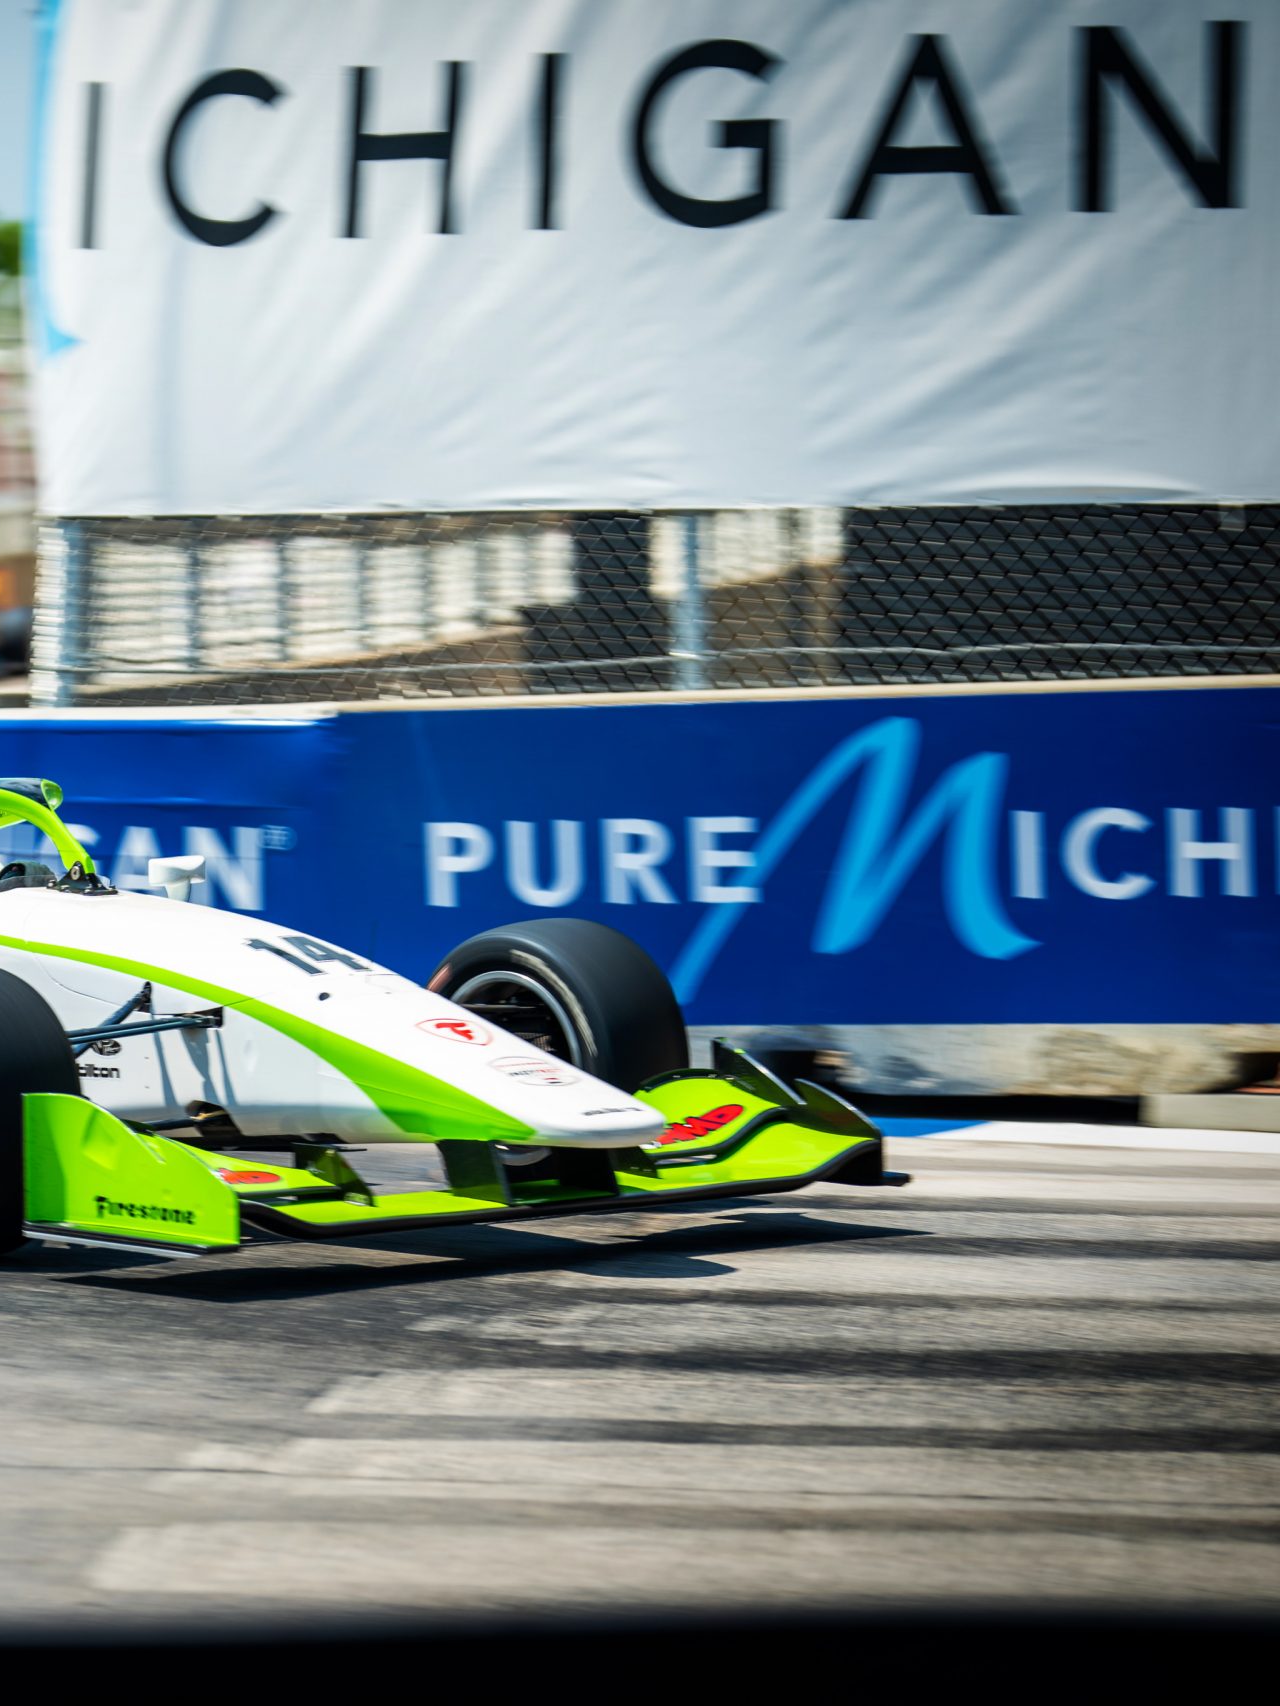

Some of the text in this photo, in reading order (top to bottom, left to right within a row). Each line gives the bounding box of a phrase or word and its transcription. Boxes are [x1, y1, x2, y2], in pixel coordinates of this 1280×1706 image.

[70, 18, 1250, 250] ICHIGAN
[422, 816, 762, 907] PURE
[243, 936, 372, 976] 14
[94, 1195, 196, 1225] Firestone
